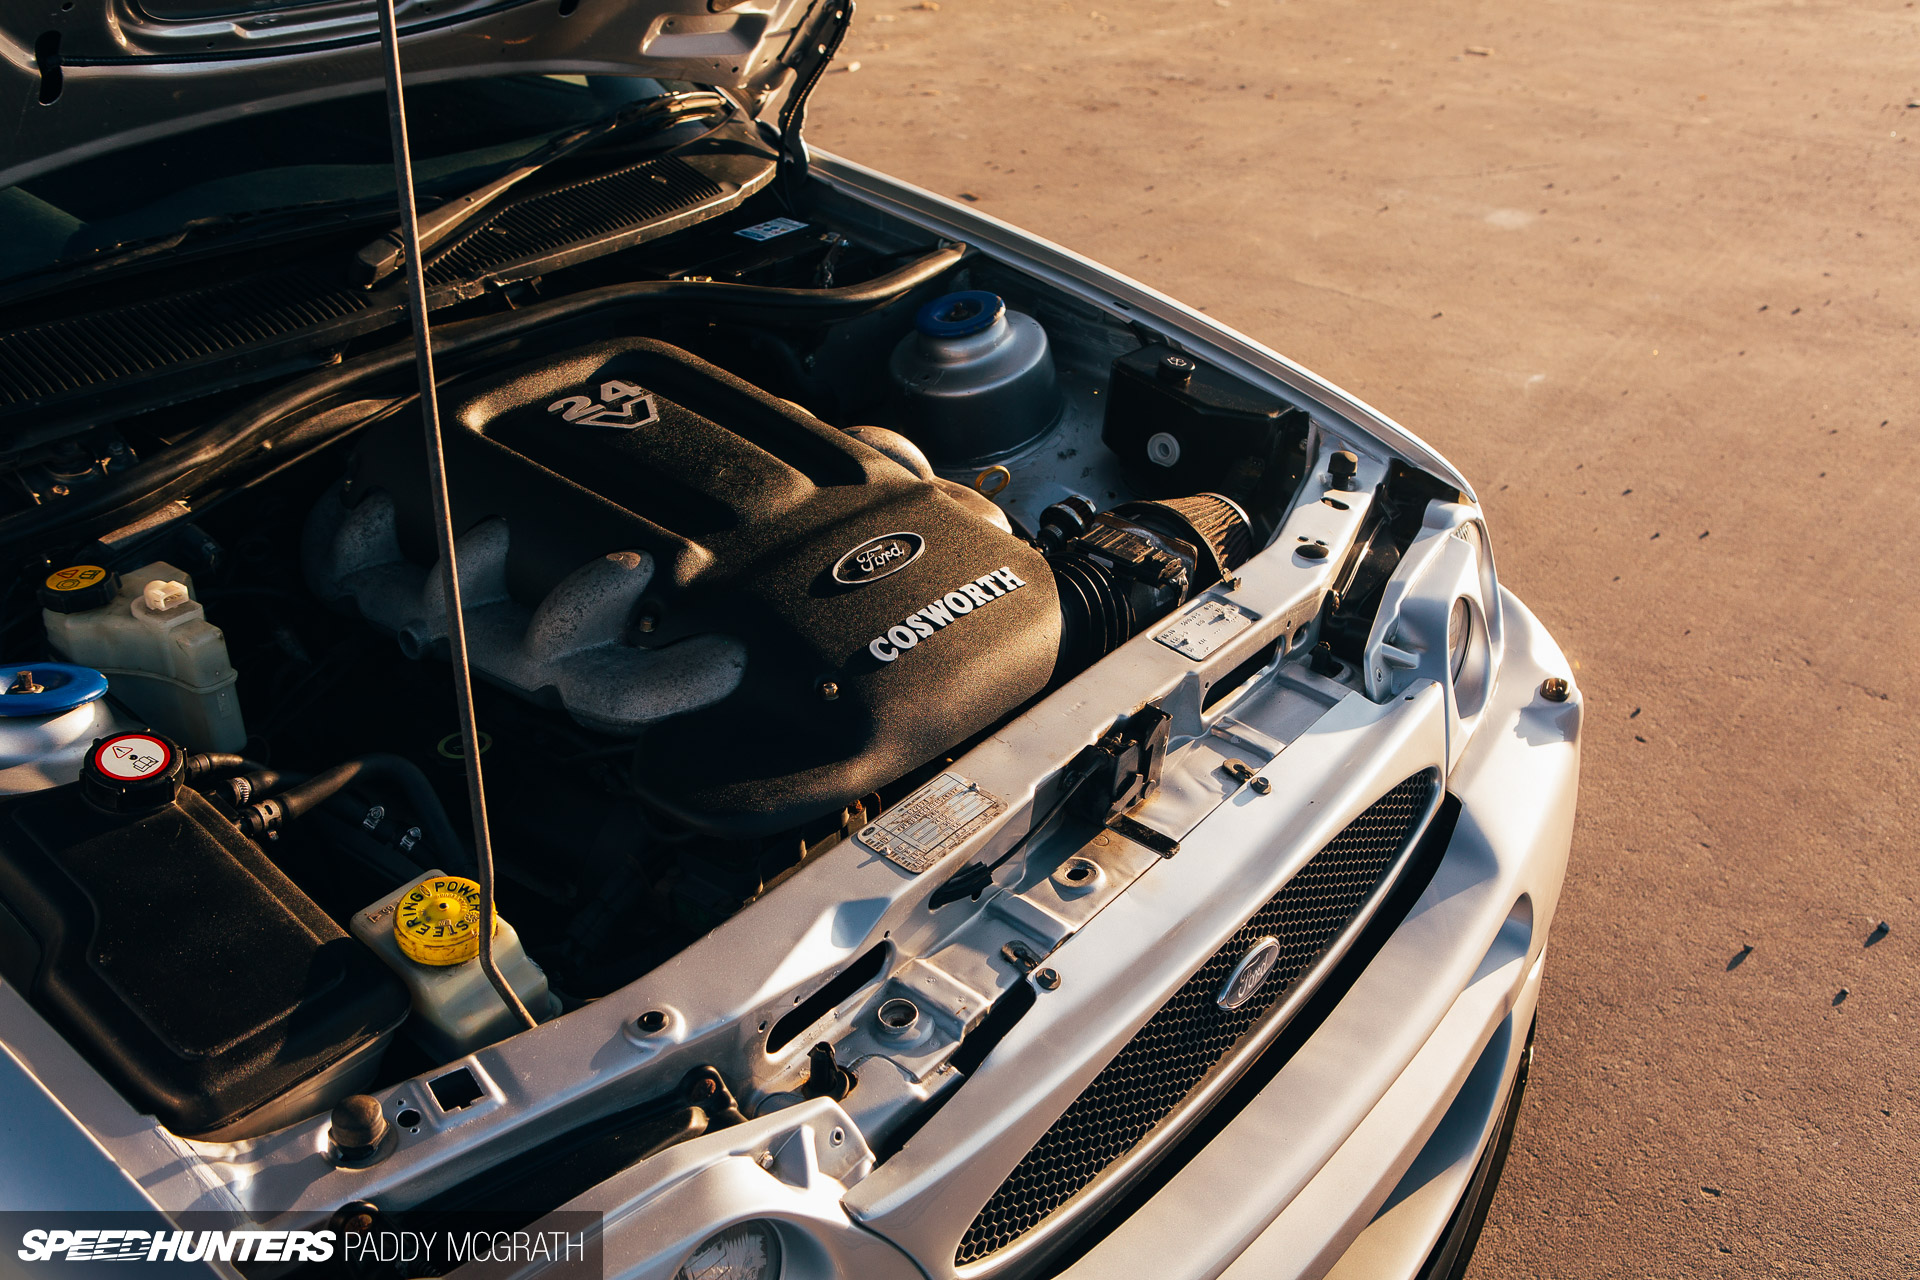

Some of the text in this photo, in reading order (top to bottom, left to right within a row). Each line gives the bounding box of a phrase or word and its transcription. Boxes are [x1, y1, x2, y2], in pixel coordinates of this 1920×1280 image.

[547, 380, 643, 422] 24
[856, 542, 905, 572] Ford
[869, 566, 1027, 662] COSWORTH
[402, 892, 469, 938] STEERING
[434, 881, 480, 912] POWER
[1238, 953, 1269, 998] Ford
